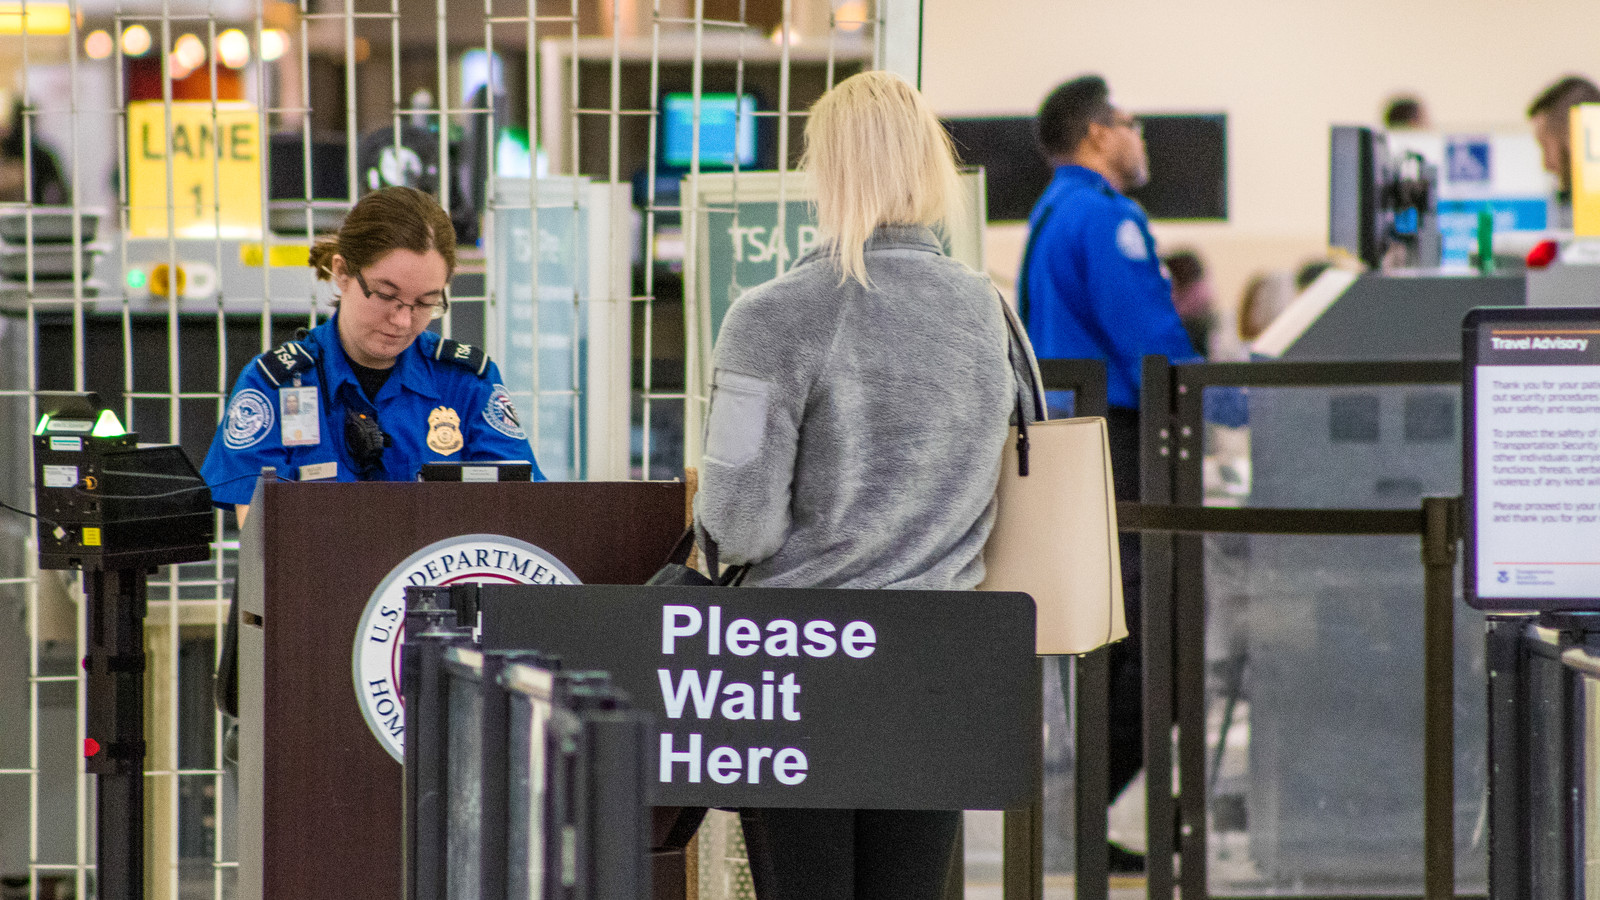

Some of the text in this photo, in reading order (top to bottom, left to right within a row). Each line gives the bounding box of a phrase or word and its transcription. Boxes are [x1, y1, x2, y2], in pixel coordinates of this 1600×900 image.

[142, 123, 254, 160] LANE
[1585, 126, 1600, 163] L
[189, 184, 203, 217] 1
[728, 225, 819, 262] TSA P
[273, 345, 298, 371] TSA
[454, 343, 472, 360] TSA
[1492, 337, 1588, 352] Travel Advisory
[1493, 441, 1598, 451] Transportation Security
[1493, 502, 1522, 510] Please
[370, 548, 565, 643] U.S. DEPARTME
[662, 605, 877, 658] Please
[369, 677, 404, 741] HOM
[657, 669, 801, 721] Wait
[659, 733, 809, 785] Here
